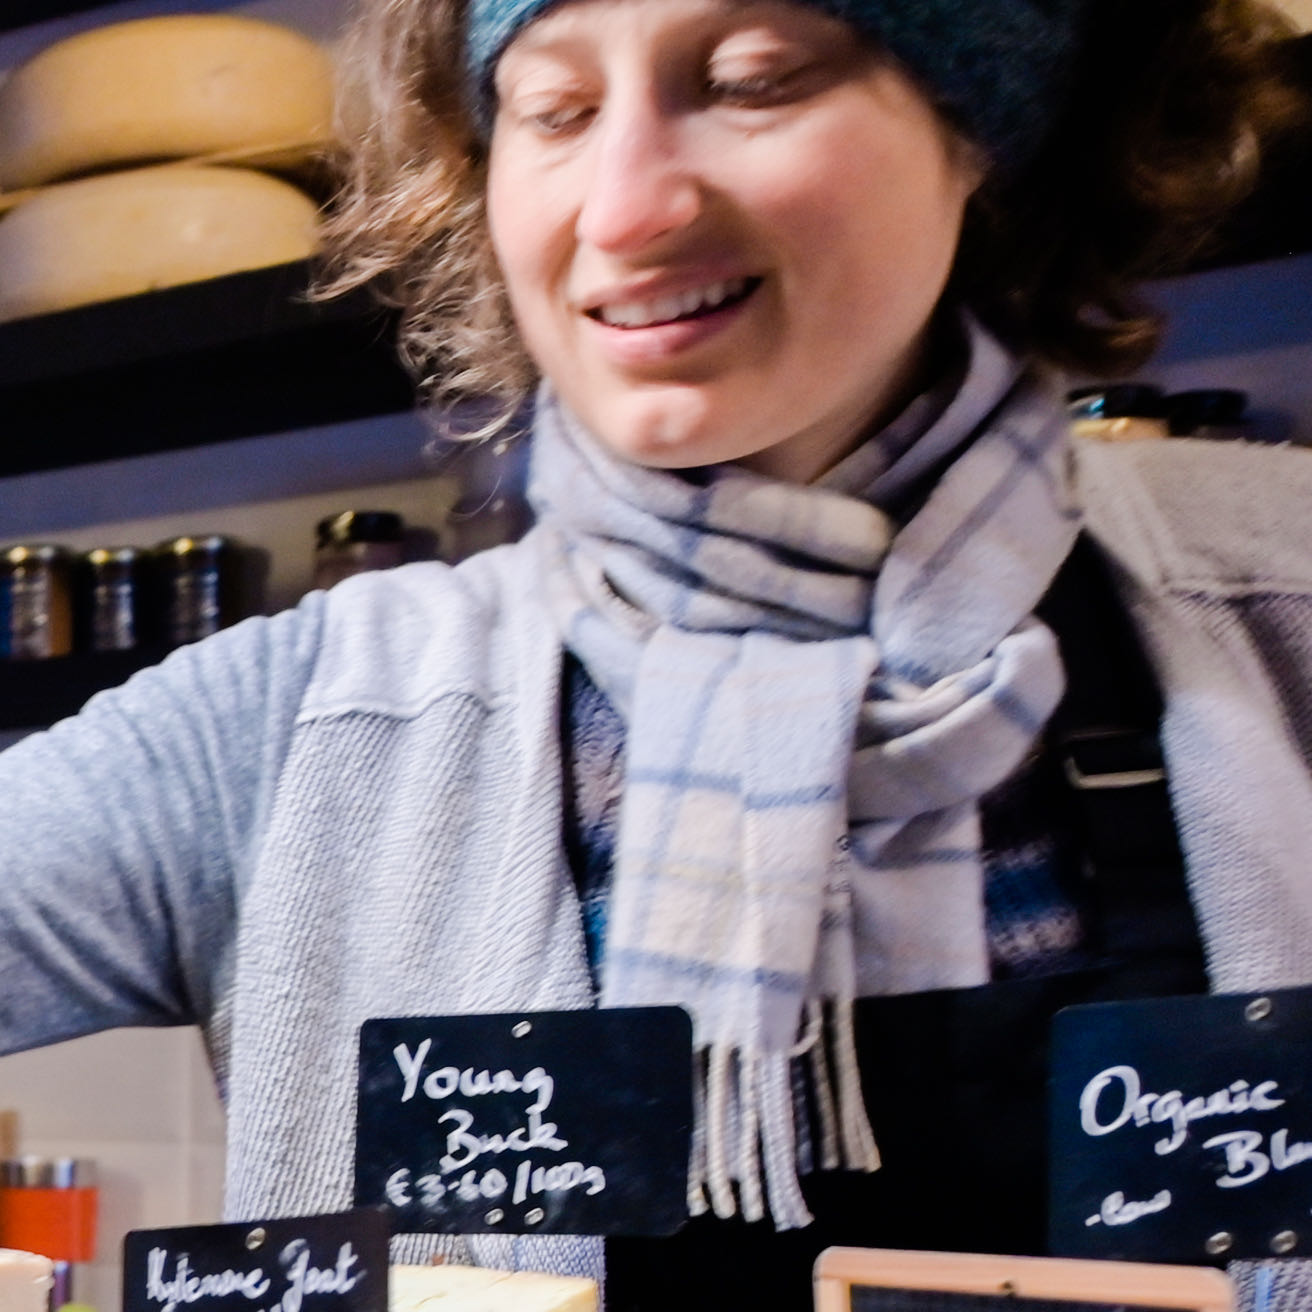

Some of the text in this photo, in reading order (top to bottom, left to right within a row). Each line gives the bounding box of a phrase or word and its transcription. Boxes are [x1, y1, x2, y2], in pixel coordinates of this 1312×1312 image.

[392, 1037, 554, 1115] Young
[1079, 1065, 1286, 1156] Organic
[437, 1107, 569, 1175] Buck
